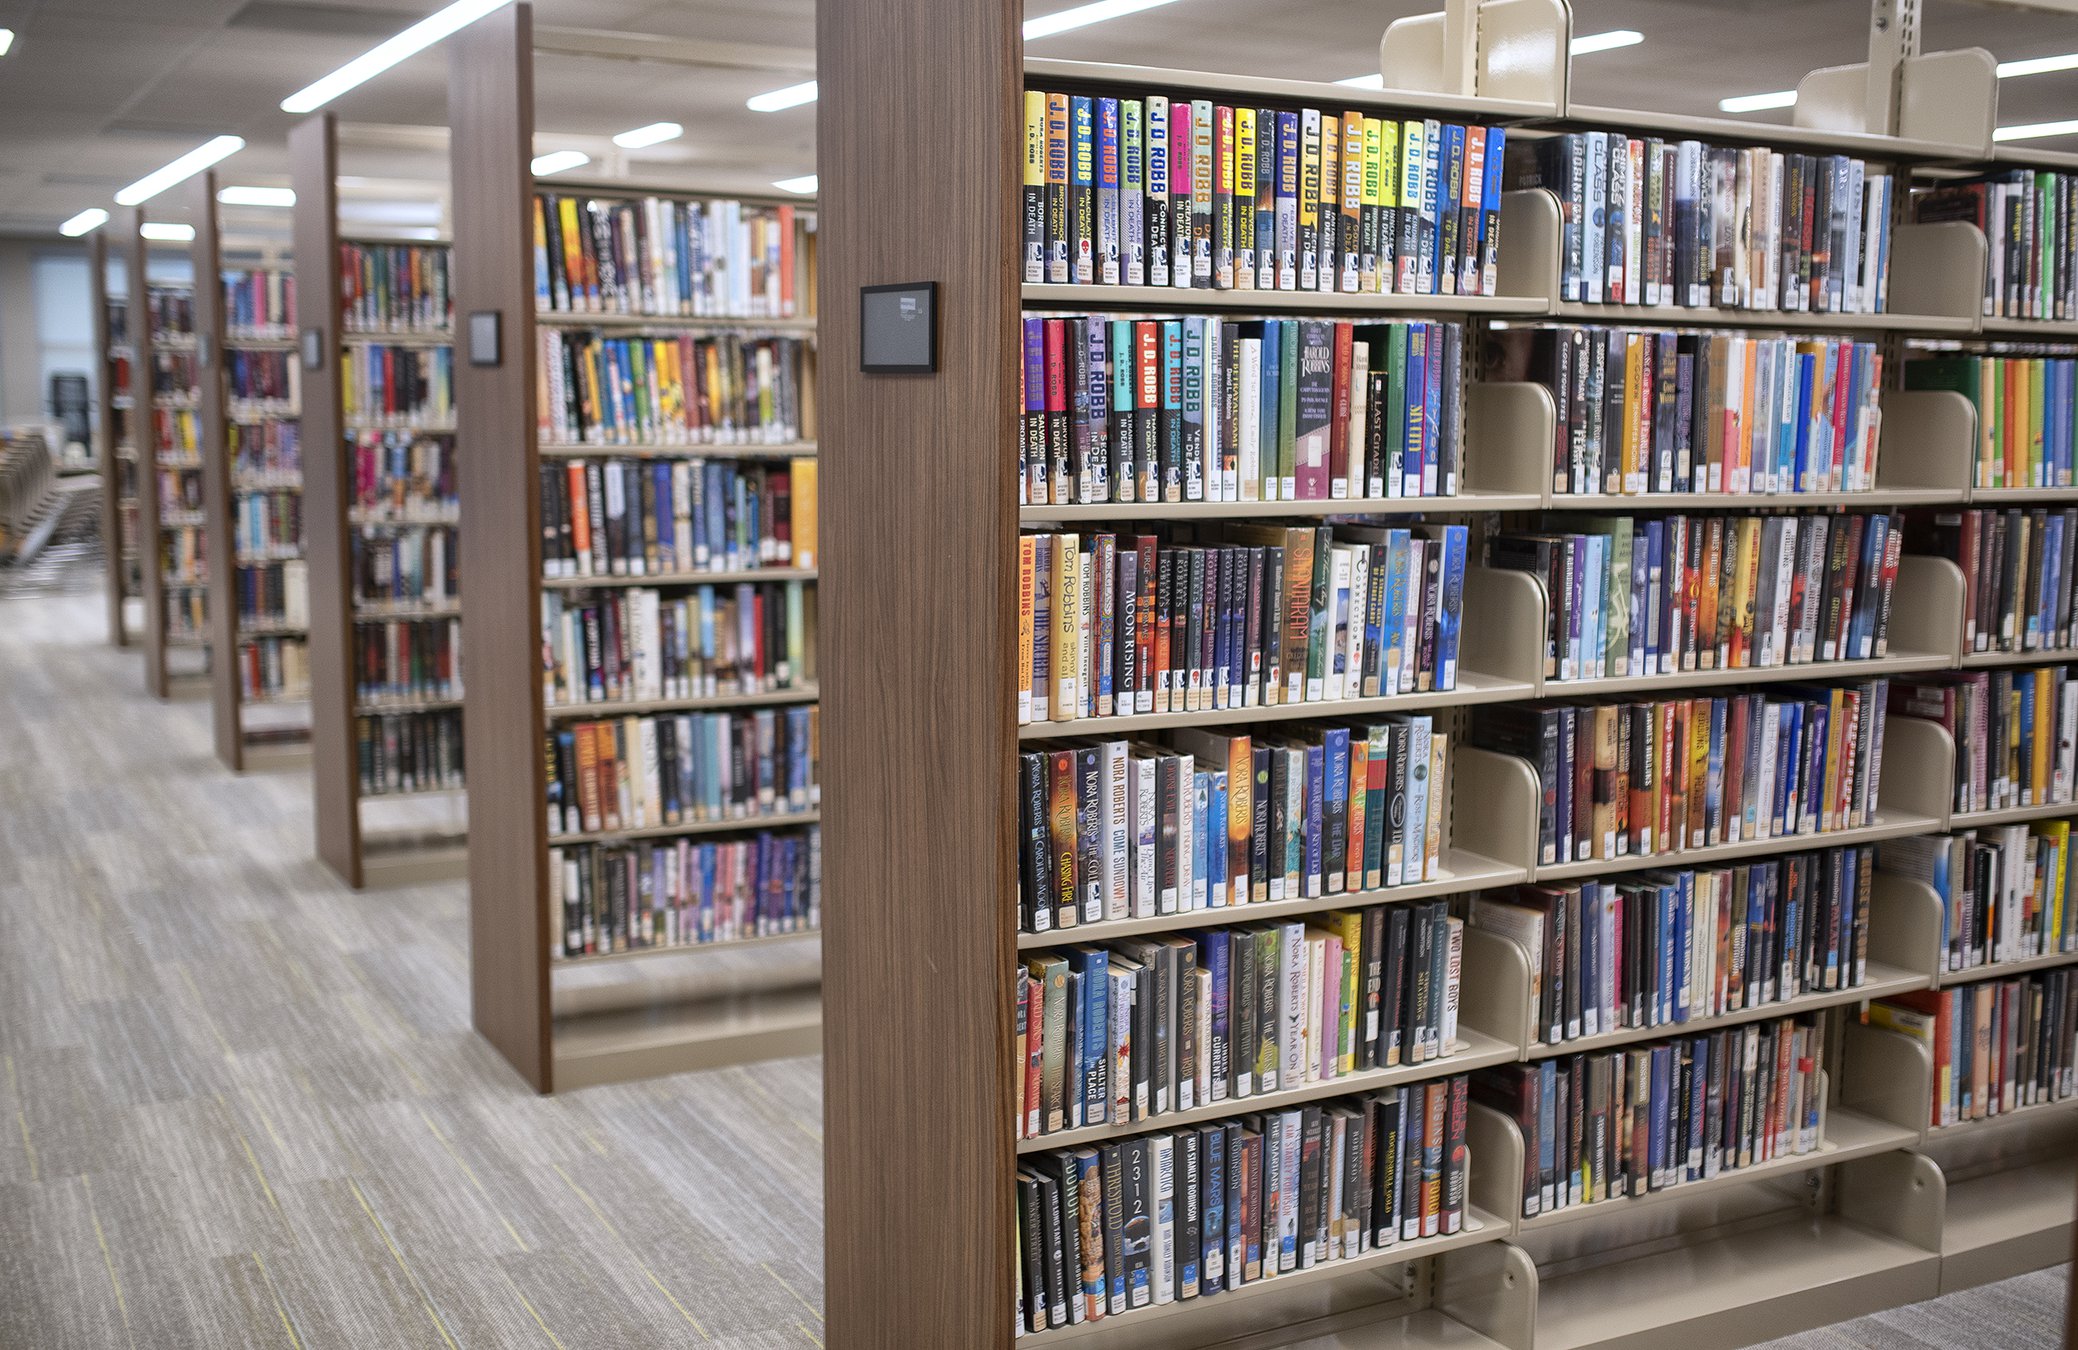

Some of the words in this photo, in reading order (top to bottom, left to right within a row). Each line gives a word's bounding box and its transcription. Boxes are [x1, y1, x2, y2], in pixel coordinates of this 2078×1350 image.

[1049, 138, 1066, 180] ROBB
[1078, 142, 1092, 181] ROBB
[1151, 147, 1166, 193] ROBB
[1241, 153, 1253, 189] ROBB
[1283, 156, 1296, 193] ROBB
[1305, 163, 1318, 213] ROBB
[1345, 160, 1361, 209] ROBB
[1366, 161, 1378, 197] ROBB
[1407, 164, 1420, 199] ROBB
[1028, 193, 1036, 204] IN
[1037, 201, 1045, 228] BORN
[1028, 206, 1036, 234] DEATH
[1302, 357, 1331, 378] ROBBINS
[1304, 346, 1329, 360] HAROLD
[1091, 371, 1105, 420] ROBB
[1144, 366, 1156, 403] ROBB
[1170, 367, 1181, 403] ROBB
[1186, 366, 1200, 412] ROBB
[1029, 417, 1037, 428] IN
[1225, 394, 1233, 420] Robbins
[1374, 401, 1382, 429] LAST
[1030, 430, 1038, 457] DEATH
[1120, 430, 1128, 456] DEATH
[1022, 542, 1032, 569] TOM
[1064, 541, 1076, 572] Tom
[1082, 562, 1090, 580] TOM
[1143, 545, 1151, 574] PURGE
[1021, 571, 1032, 616] ROBBINS
[1082, 581, 1090, 616] ROBBINS
[1159, 559, 1167, 608] ROBERTS
[1176, 559, 1184, 608] ROBERTS
[1289, 547, 1312, 640] SHANTARAM
[1426, 582, 1438, 605] NORA
[1063, 576, 1077, 633] Robbins
[1124, 591, 1136, 636] MOON
[1034, 609, 1049, 633] THE
[1424, 605, 1435, 641] ROBERTS
[1033, 635, 1049, 681] SECRET
[1061, 642, 1069, 662] and
[1067, 642, 1076, 674] skinny
[1124, 640, 1135, 688] RISING
[1031, 763, 1042, 788] NORA
[1112, 756, 1125, 782] NORA
[1235, 755, 1249, 783] NORA
[1333, 751, 1345, 778] NORA
[1085, 771, 1099, 800] NORA
[1331, 778, 1345, 814] ROBERTS
[1031, 789, 1042, 826] ROBERTS
[1082, 800, 1099, 837] ROBERTS
[1112, 784, 1125, 825] ROBERTS
[1139, 788, 1148, 826] ROBERTS
[1234, 784, 1248, 824] ROBERTS
[1113, 830, 1125, 856] COME
[1035, 840, 1045, 882] CAROLINA
[1060, 852, 1072, 886] CHASING
[1061, 887, 1072, 903] FIRE
[1290, 937, 1301, 968] NORA
[1450, 929, 1462, 951] TWO
[1264, 951, 1276, 977] NORA
[1368, 961, 1381, 975] THE
[1449, 956, 1462, 981] LOST
[1092, 967, 1106, 998] NORA
[1183, 966, 1194, 996] NORA
[1263, 978, 1276, 1014] ROBERTS
[1289, 971, 1301, 1012] ROBERTS
[1368, 977, 1381, 994] END
[1053, 996, 1065, 1022] NORA
[1447, 984, 1459, 1012] BOYS
[1092, 1002, 1106, 1050] ROBERTS
[1184, 998, 1194, 1036] ROBERTS
[1264, 1020, 1276, 1035] THE
[1051, 1024, 1064, 1060] ROBERTS
[1289, 1022, 1300, 1051] YEAR
[1221, 1042, 1229, 1073] UNDER
[1087, 1070, 1097, 1100] PLACE
[1097, 1058, 1107, 1099] SHELTER
[1451, 1079, 1461, 1139] UNSEEN
[1187, 1137, 1196, 1151] KIM
[1271, 1121, 1280, 1139] THE
[1209, 1132, 1222, 1163] BLUE
[1231, 1137, 1241, 1190] ROBINSON
[1350, 1130, 1361, 1183] ROBINSON
[1187, 1152, 1196, 1184] STANLEY
[1051, 1190, 1060, 1206] THE
[1064, 1164, 1078, 1220] DONOR
[1107, 1162, 1122, 1230] THRESHOLD
[1209, 1167, 1222, 1205] MARS
[1052, 1206, 1061, 1227] LONG
[1187, 1184, 1196, 1222] ROBINSON
[1053, 1228, 1062, 1246] TAKE
